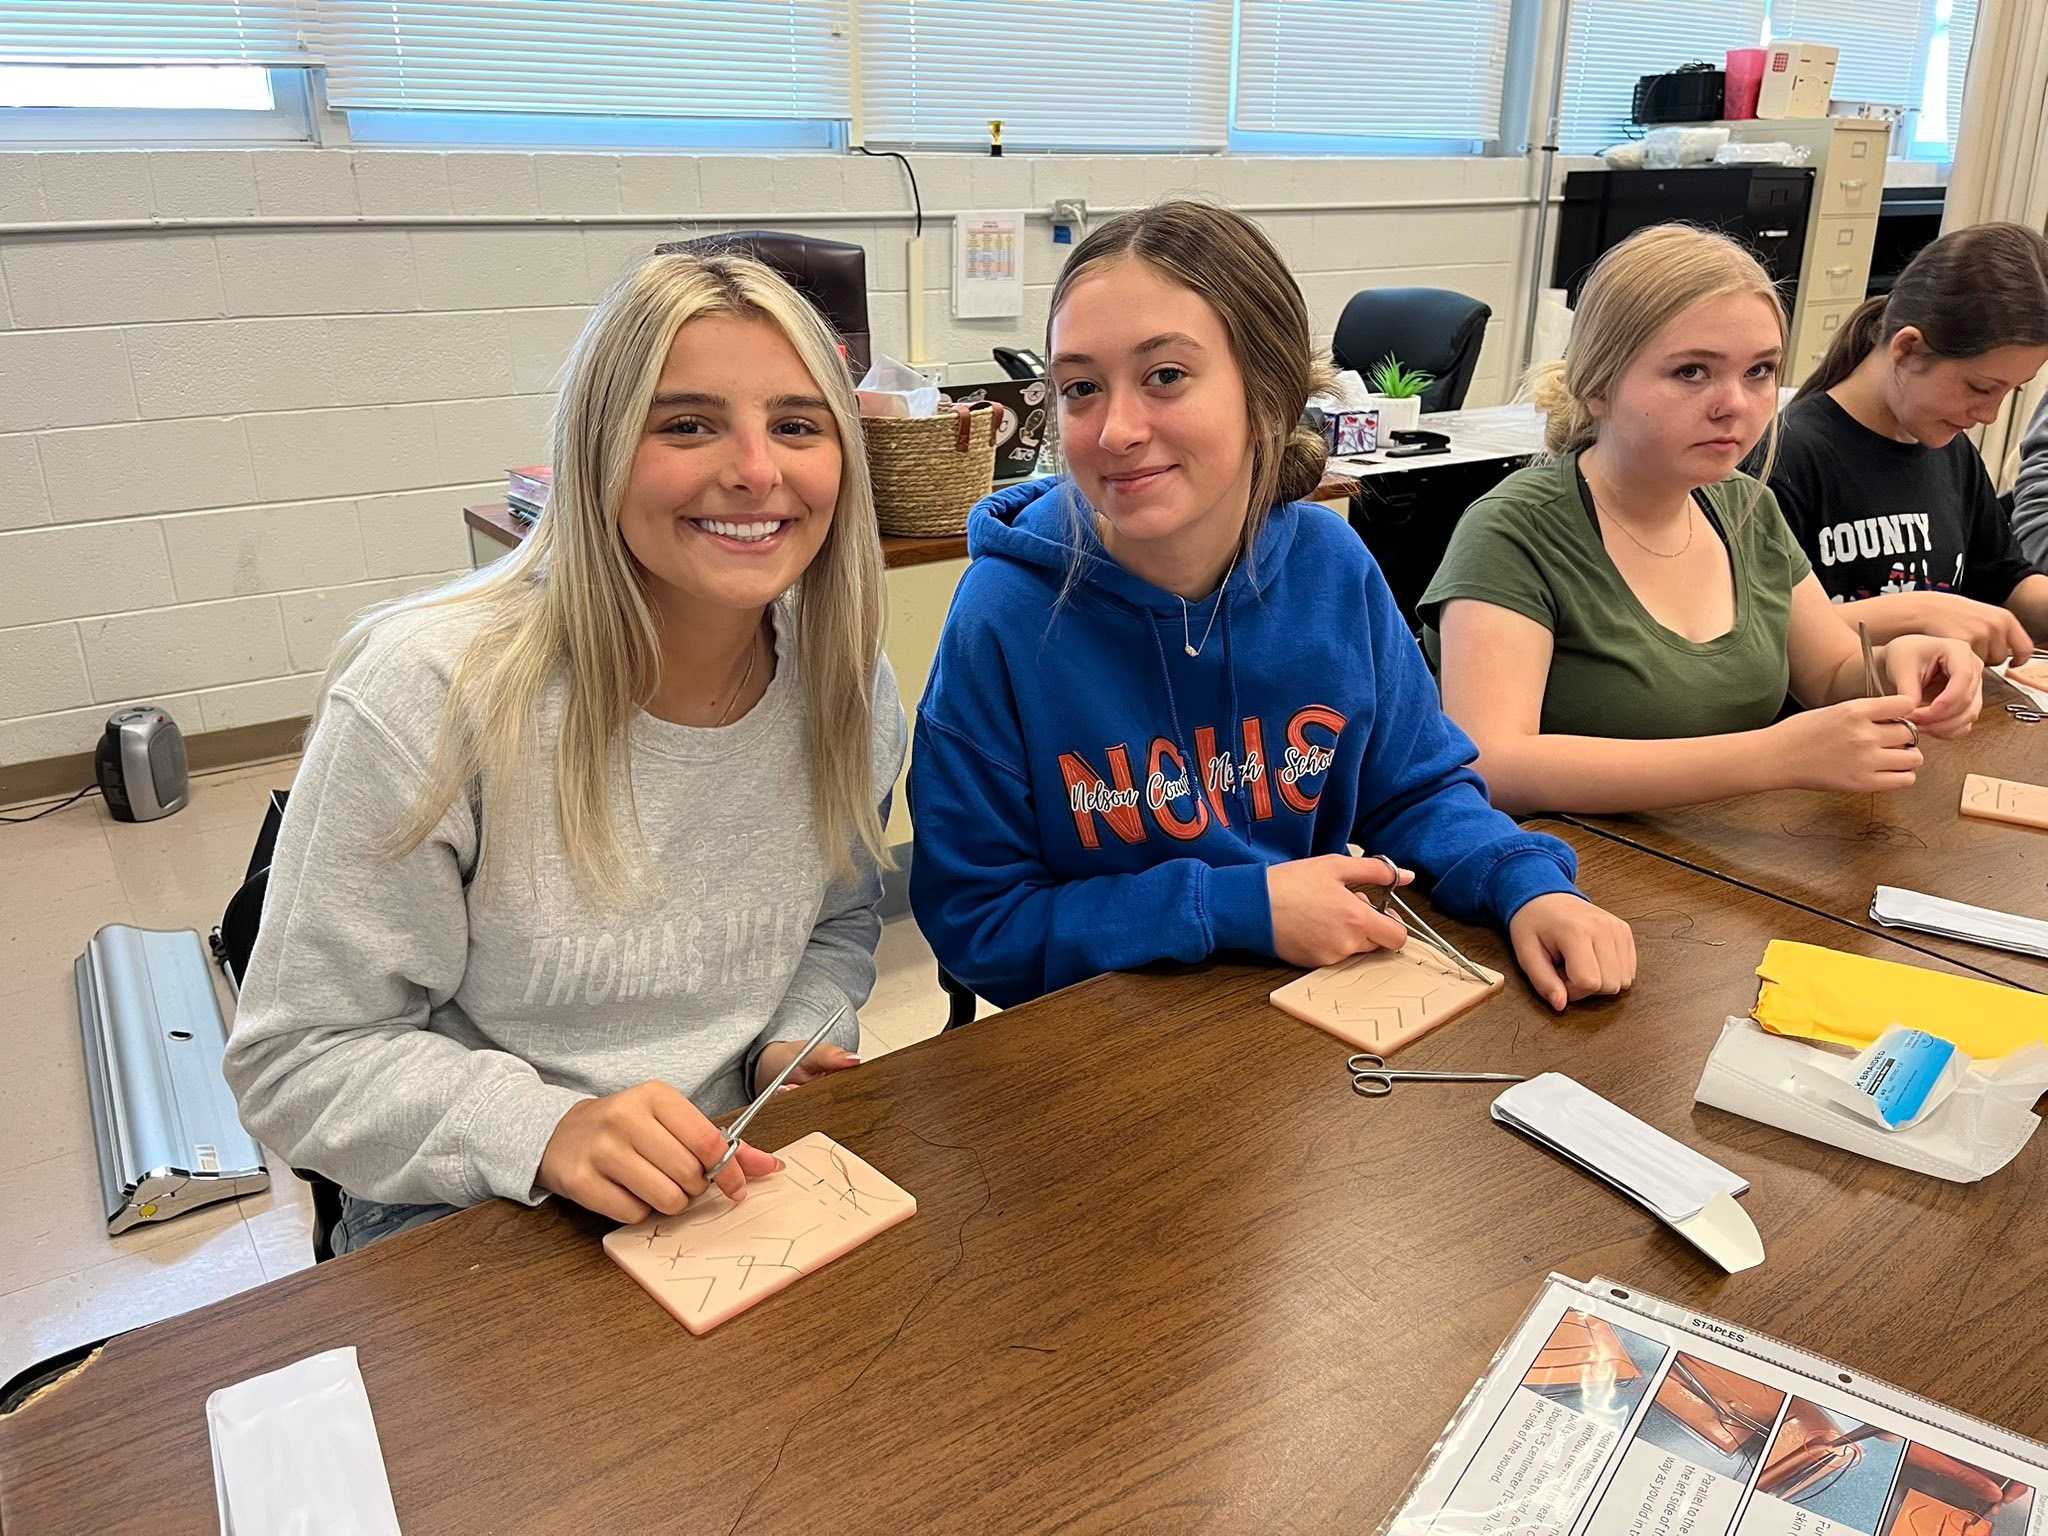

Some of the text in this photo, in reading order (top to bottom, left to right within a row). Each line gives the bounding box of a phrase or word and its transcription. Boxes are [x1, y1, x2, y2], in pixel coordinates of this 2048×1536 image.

[1819, 513, 1932, 566] COUNTY
[1071, 780, 1139, 814] Nelson
[523, 915, 703, 1006] THOMAS
[1860, 1051, 1885, 1080] BRAIDED
[1692, 1318, 1745, 1343] STAPLES
[1532, 1400, 1547, 1413] left
[1522, 1413, 1537, 1430] side
[1544, 1407, 1562, 1430] about
[1517, 1431, 1526, 1441] of
[1508, 1440, 1522, 1454] the
[1510, 1446, 1539, 1490] centimeter
[1658, 1457, 1675, 1474] way
[1681, 1465, 1695, 1480] the
[1534, 1470, 1548, 1484] the
[1655, 1474, 1666, 1485] as
[1647, 1483, 1661, 1502] you
[1673, 1480, 1689, 1496] left
[1639, 1503, 1653, 1520] did
[1664, 1497, 1680, 1515] side
[1680, 1474, 1716, 1533] Parallel to the
[1659, 1516, 1669, 1529] of
[1792, 1511, 1808, 1531] skin
